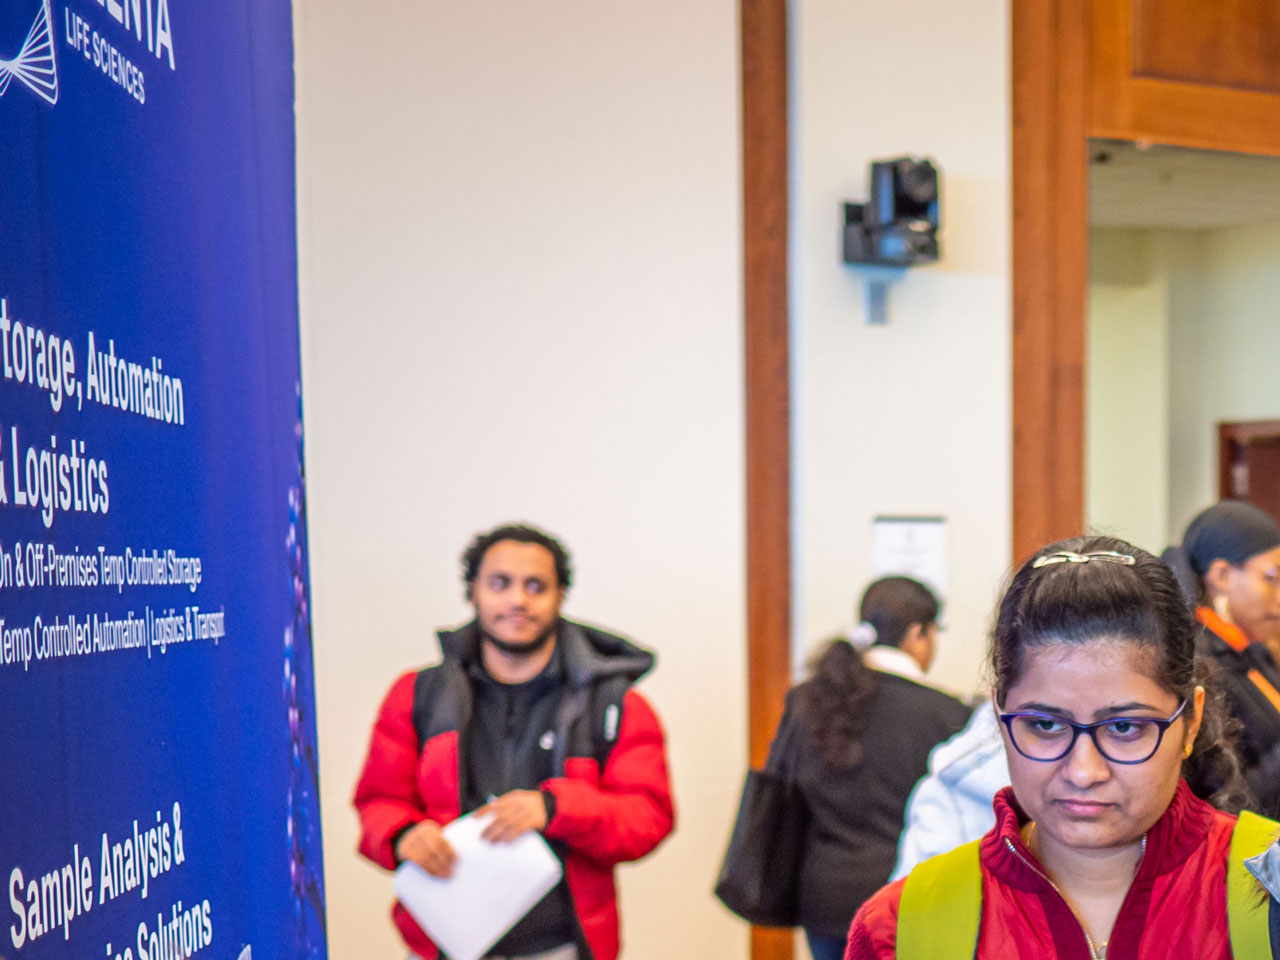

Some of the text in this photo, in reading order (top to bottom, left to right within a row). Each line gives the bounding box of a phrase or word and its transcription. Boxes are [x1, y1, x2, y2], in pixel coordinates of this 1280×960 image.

[65, 7, 145, 104] LIFE SCIENCES
[87, 331, 185, 425] Automation
[11, 426, 110, 529] Logistics
[15, 542, 25, 587] &
[26, 542, 99, 586] Off-Premises
[98, 546, 125, 594] Temp
[125, 547, 168, 586] Controlled
[167, 548, 202, 593] Storage
[34, 613, 91, 660] Controlled
[93, 610, 146, 653] Automation
[150, 608, 185, 654] Logistics
[185, 606, 193, 641] &
[9, 802, 185, 949] Sample Analysis &
